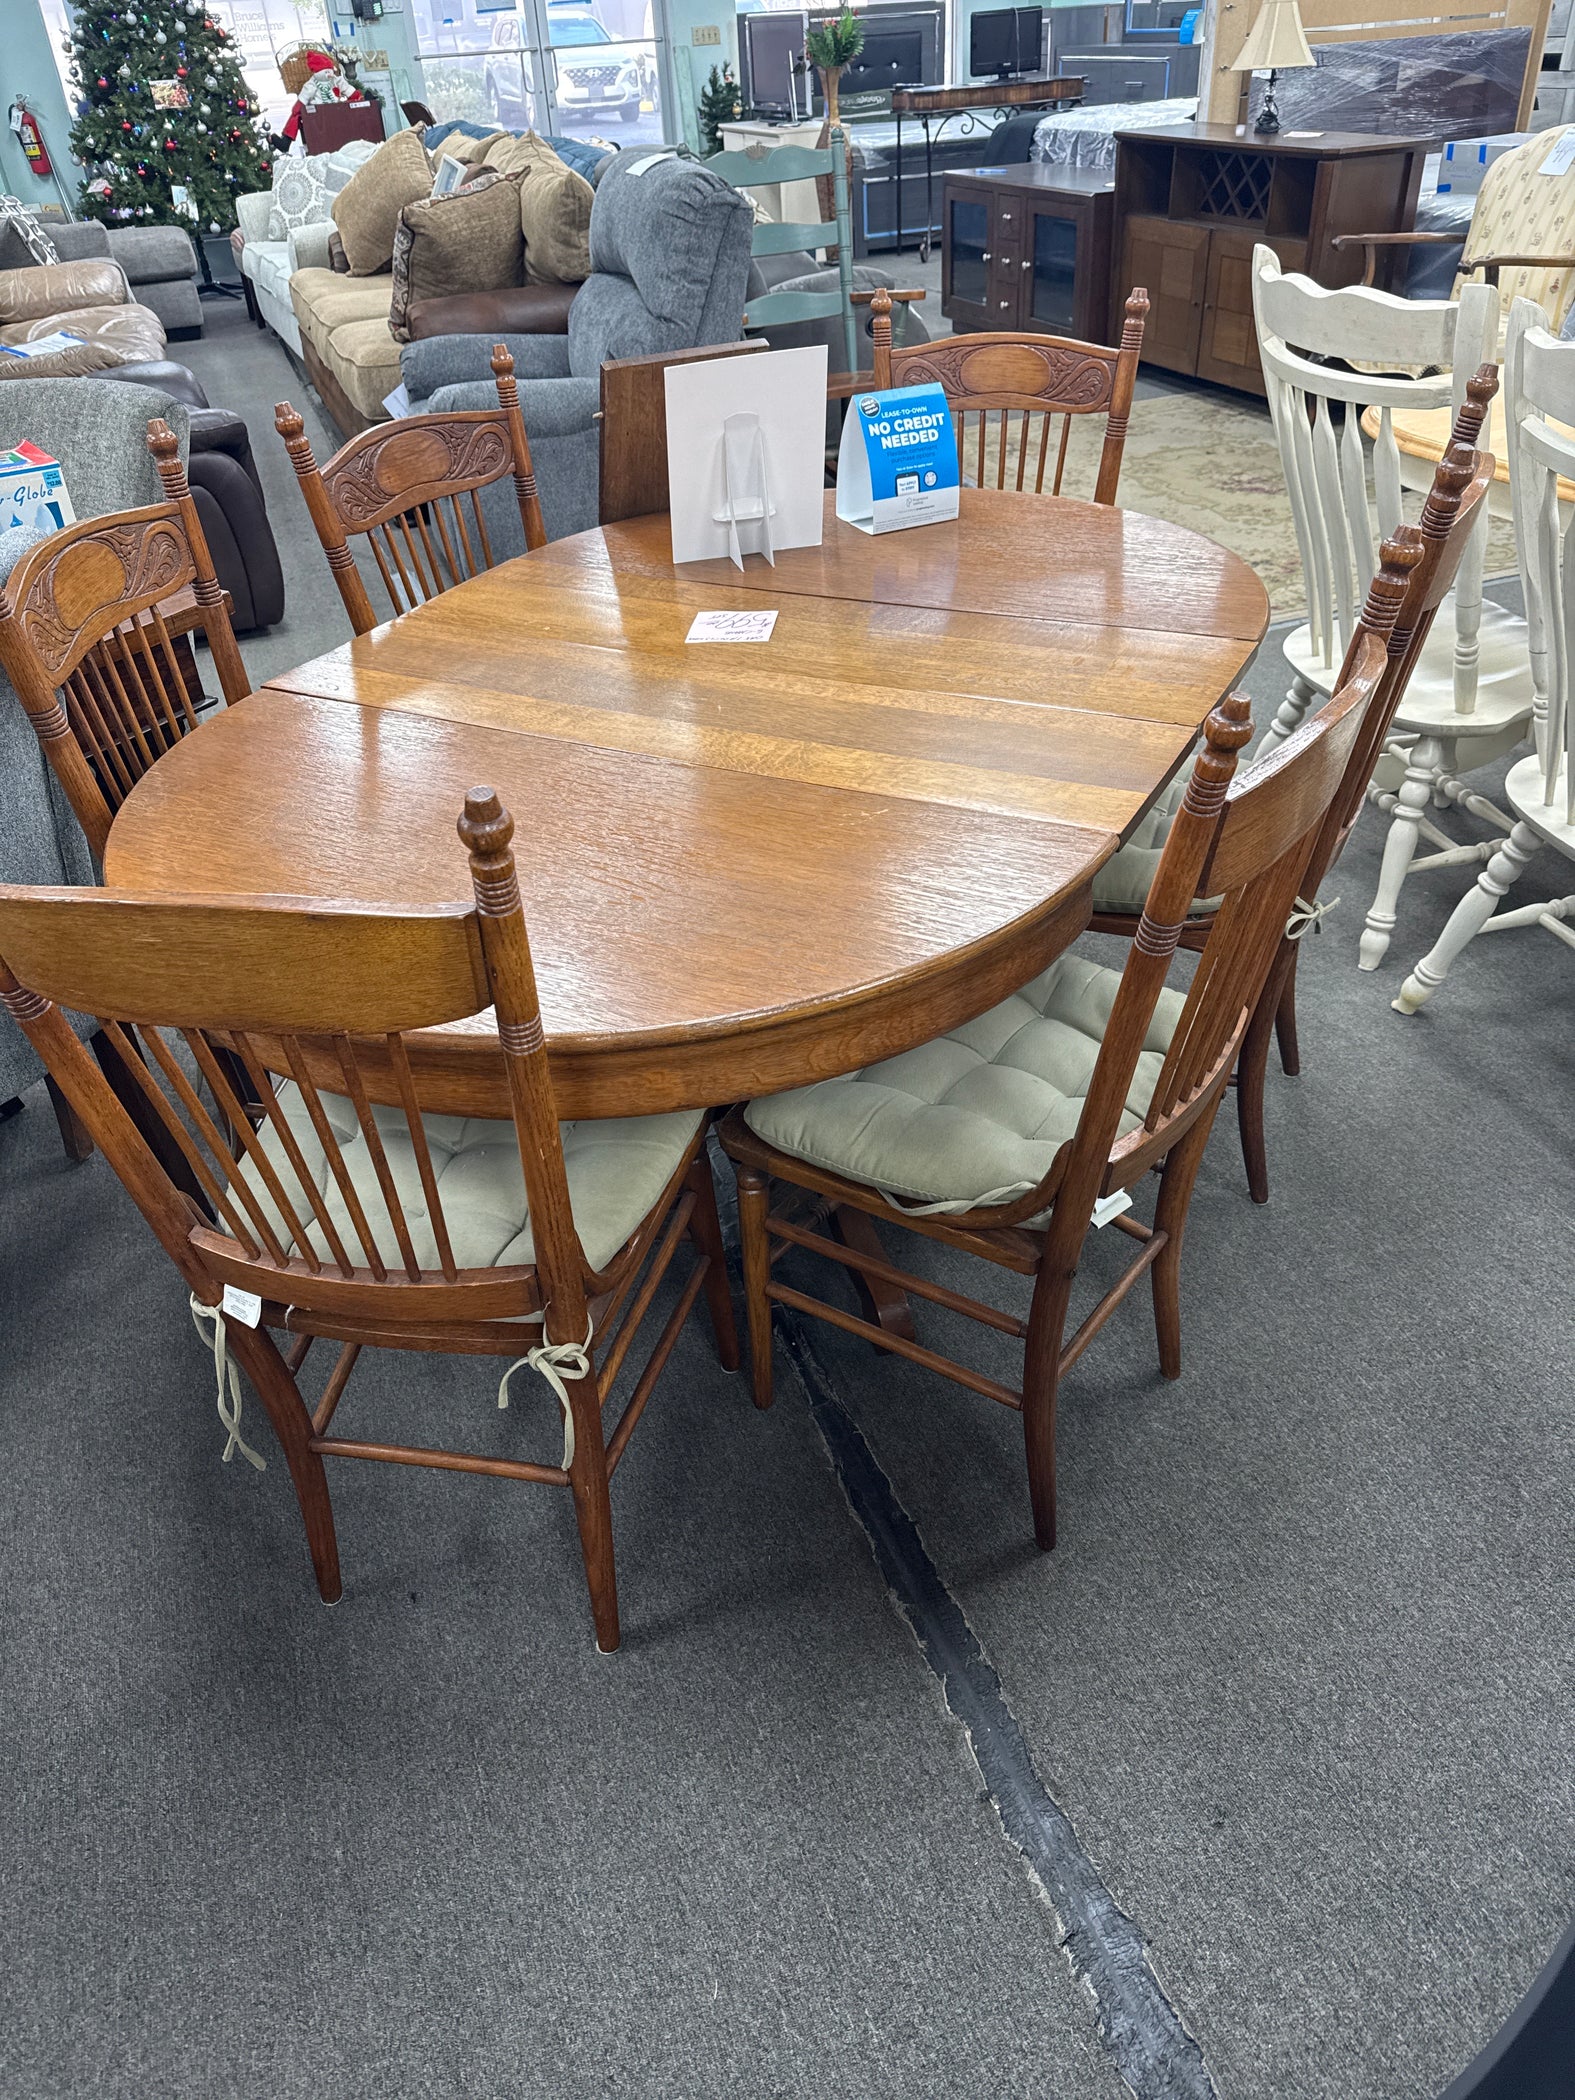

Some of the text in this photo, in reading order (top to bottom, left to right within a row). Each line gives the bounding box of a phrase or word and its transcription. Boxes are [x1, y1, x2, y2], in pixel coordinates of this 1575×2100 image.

[235, 11, 264, 21] Bruce
[236, 21, 285, 32] Williams
[240, 34, 276, 43] Homes
[881, 406, 928, 419] LEASE-TO-OWN
[868, 413, 945, 437] NO CREDIT
[881, 429, 939, 449] NEEDED
